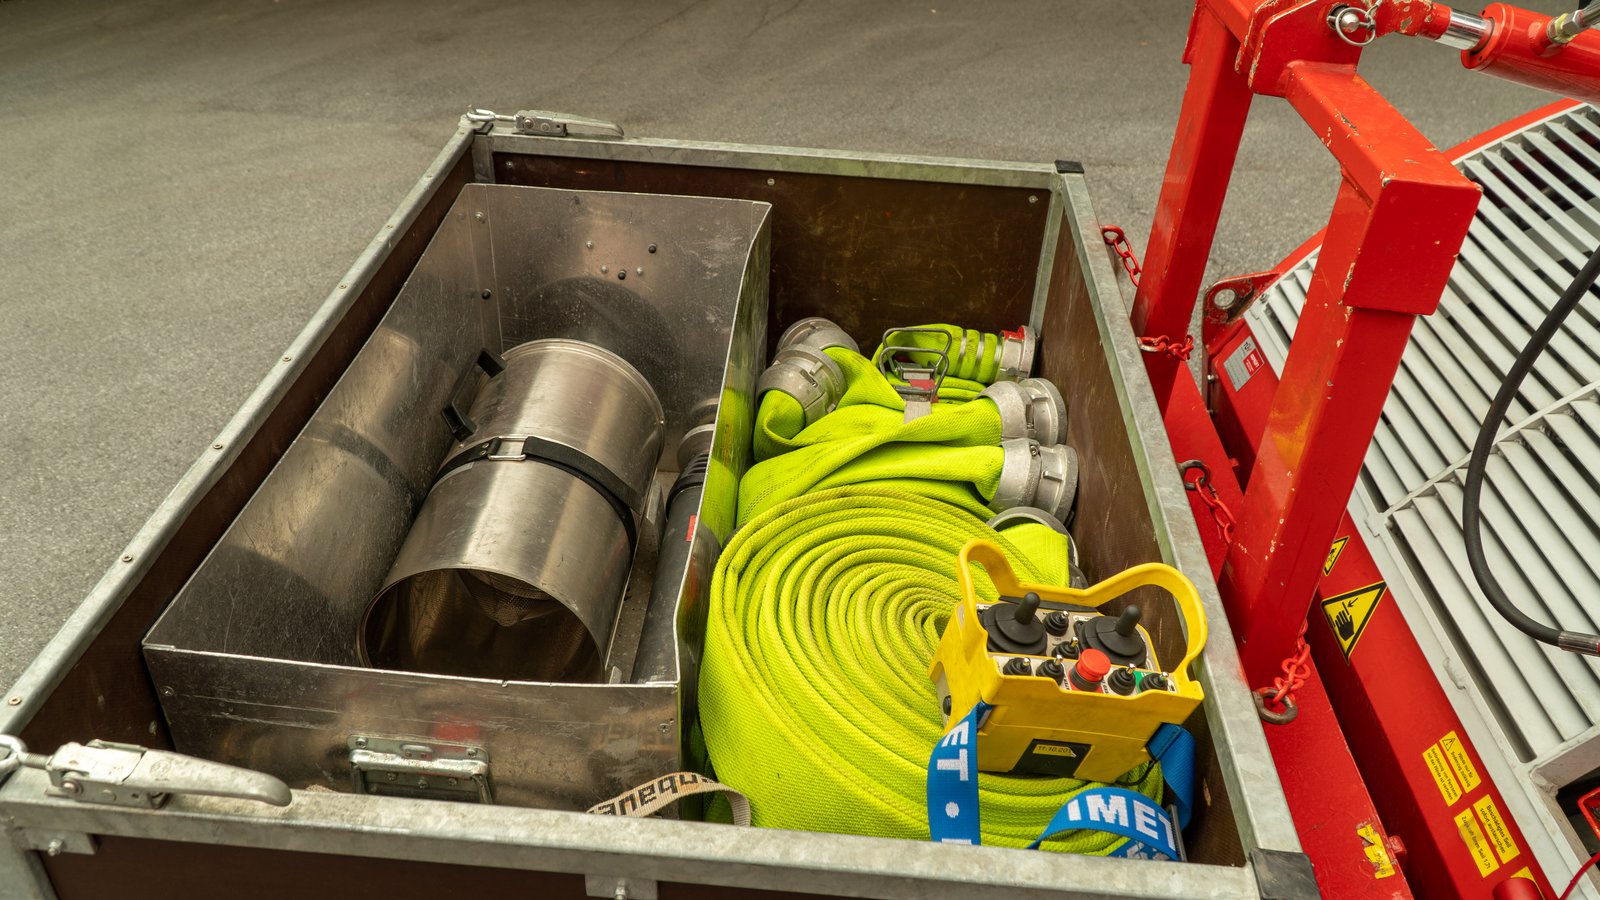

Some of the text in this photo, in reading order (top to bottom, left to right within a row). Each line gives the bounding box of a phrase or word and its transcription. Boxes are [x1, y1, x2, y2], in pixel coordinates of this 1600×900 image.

[1067, 794, 1176, 851] IMET
[1488, 822, 1505, 853] austauschen
[1504, 837, 1512, 848] Seil
[1478, 848, 1486, 859] Seil
